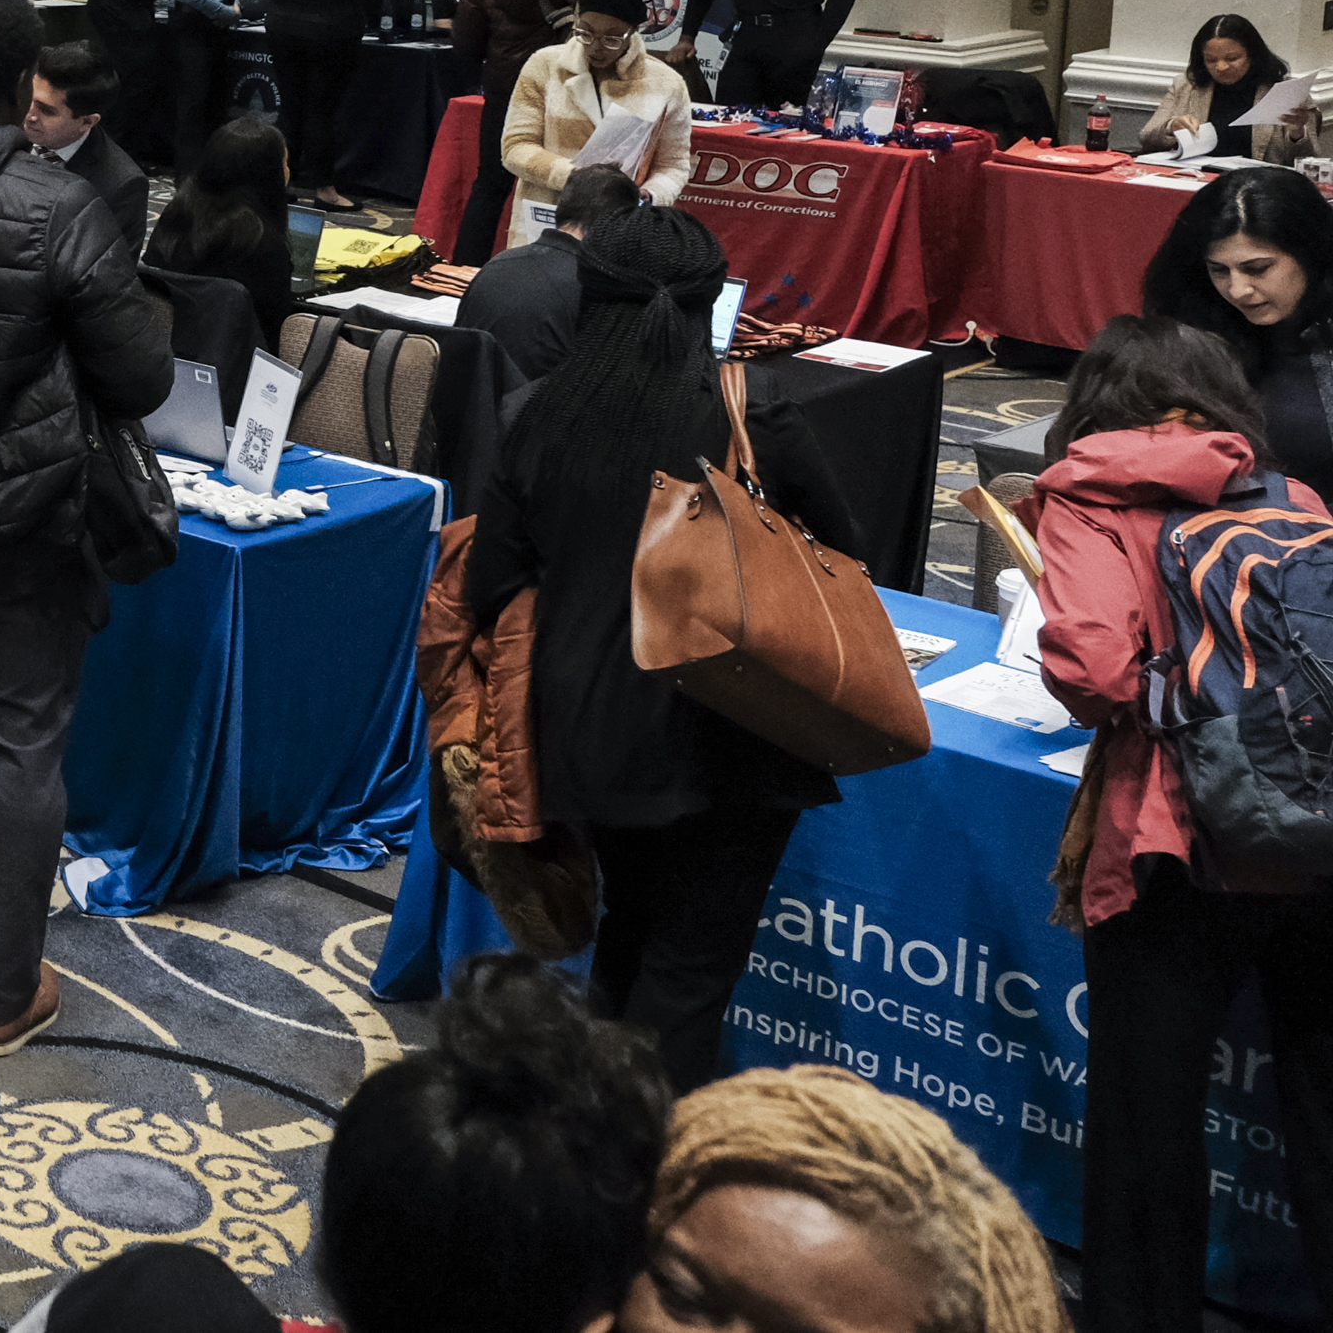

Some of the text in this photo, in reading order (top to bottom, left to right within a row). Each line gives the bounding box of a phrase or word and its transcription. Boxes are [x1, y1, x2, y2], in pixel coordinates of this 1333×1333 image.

[678, 194, 837, 218] artment of Corrections
[688, 150, 849, 203] DOC
[758, 888, 1041, 1019] atholic
[745, 951, 964, 1047] RCHDIOCESE
[976, 1032, 1027, 1063] OF
[894, 1056, 1005, 1125] Hope,
[1020, 1102, 1084, 1149] Bui
